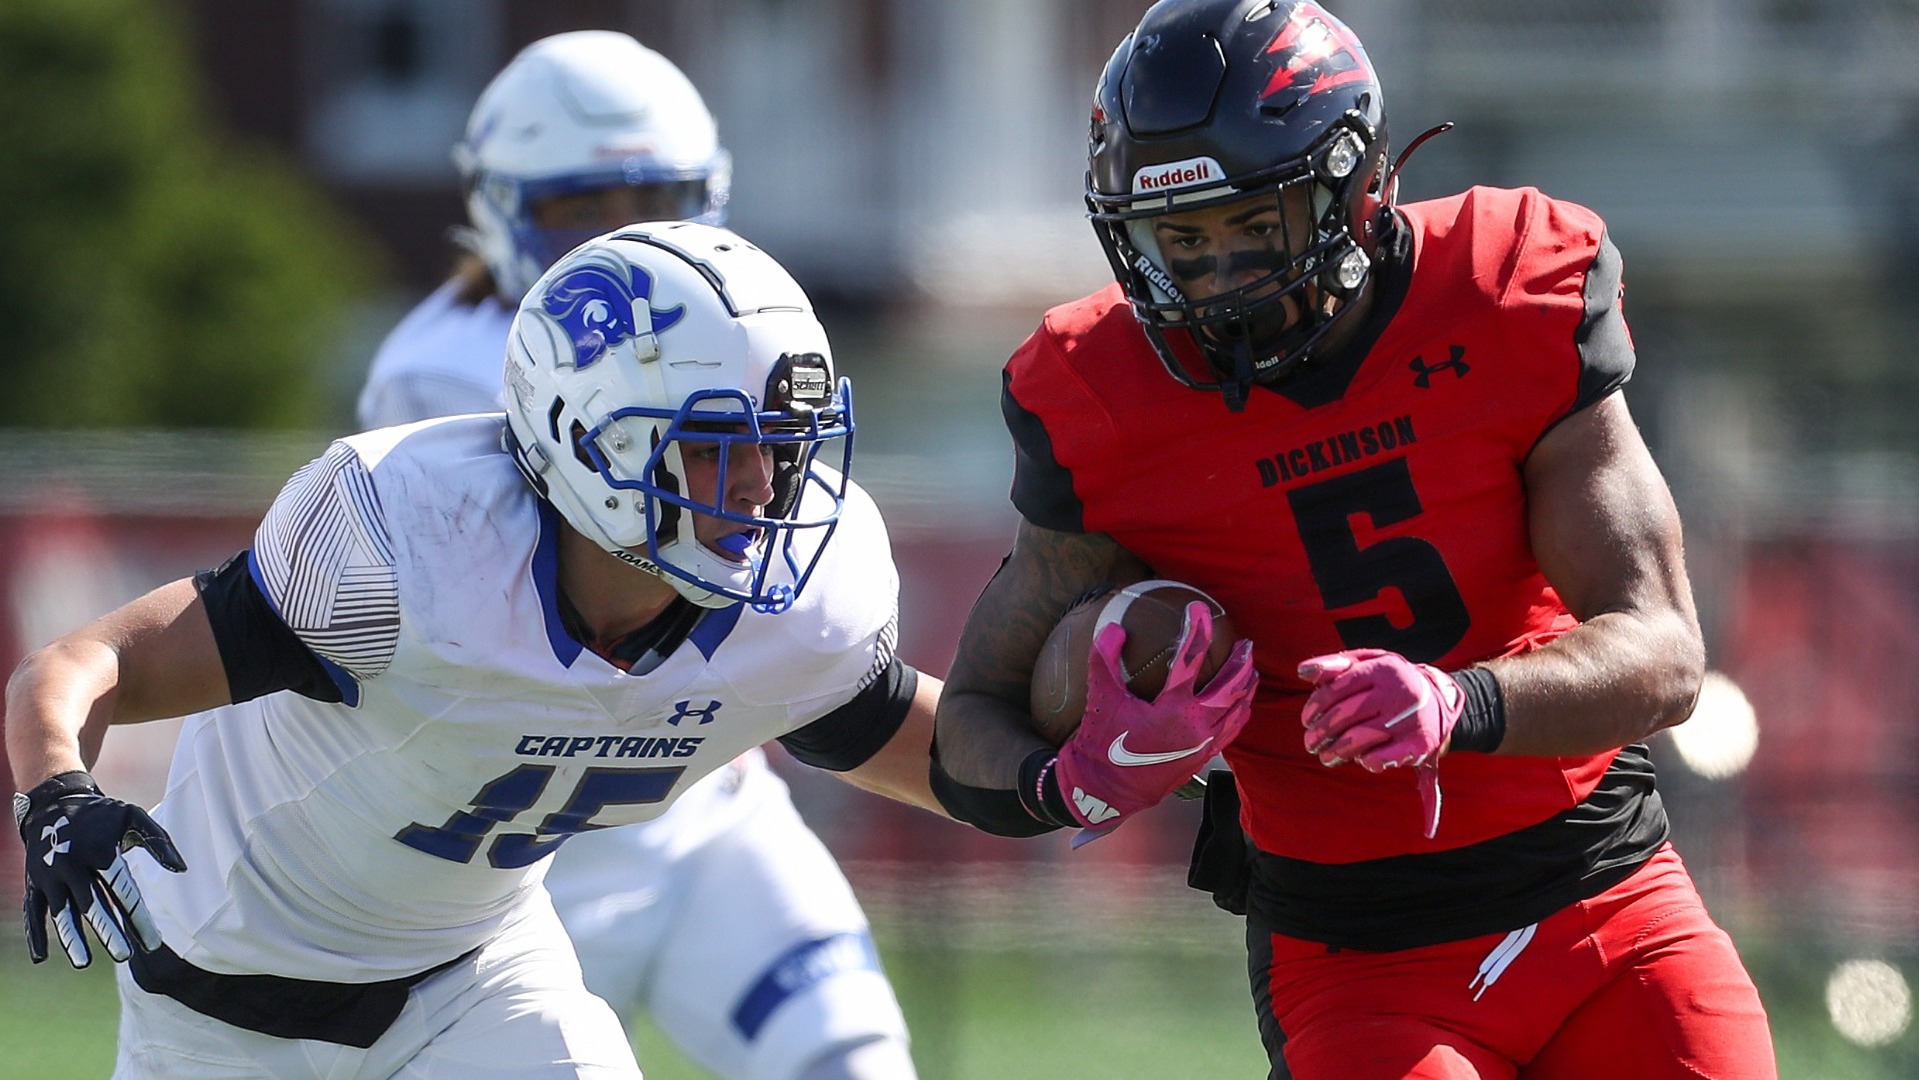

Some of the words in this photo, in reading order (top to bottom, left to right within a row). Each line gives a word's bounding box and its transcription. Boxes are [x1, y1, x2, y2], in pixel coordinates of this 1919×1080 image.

[1139, 161, 1210, 189] Riddell
[1256, 415, 1417, 488] DICKINSON
[1286, 456, 1472, 664] 5
[515, 735, 706, 758] CAPTAINS
[392, 763, 687, 869] 15
